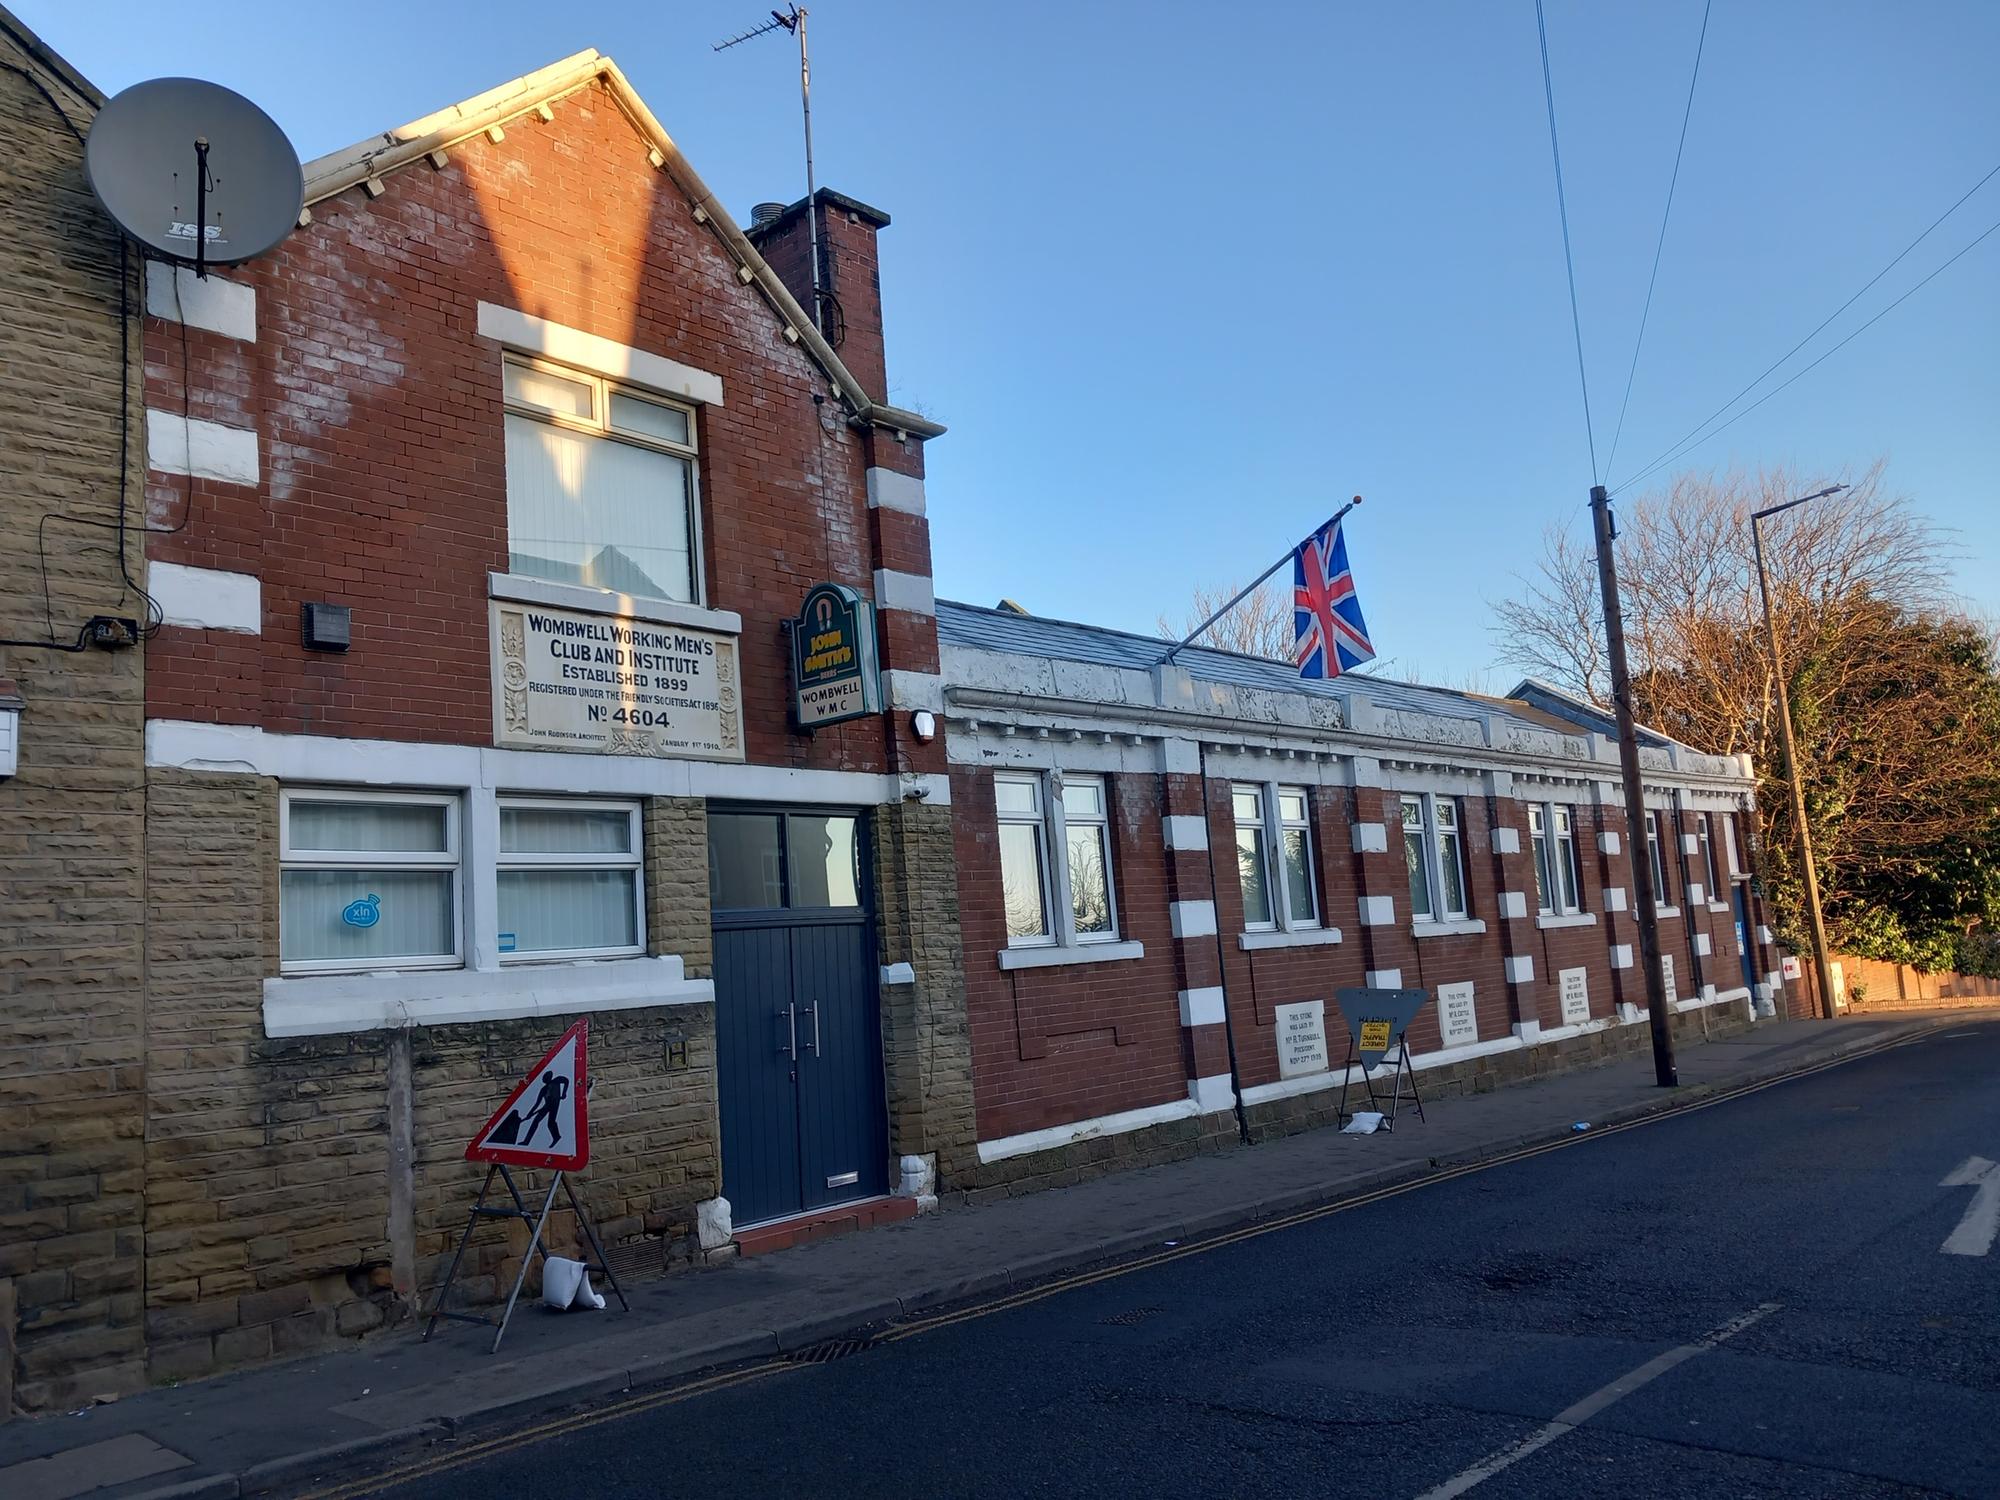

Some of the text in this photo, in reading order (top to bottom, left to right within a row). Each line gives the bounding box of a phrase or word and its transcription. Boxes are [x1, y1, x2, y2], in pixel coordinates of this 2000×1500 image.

[528, 613, 714, 657] WOMBWELL WORKING MEN'S
[810, 629, 843, 656] JOHN
[550, 638, 700, 675] CLUB AND INSTITUTE
[562, 663, 689, 692] ESTABLISHED 1899
[528, 681, 720, 712] REGISTERED UNDER THE FRIENDLY SOCIETIES ACT 1896
[801, 681, 861, 705] WOMBWELL
[529, 728, 547, 737] JOHN
[660, 738, 689, 748] JANUARY
